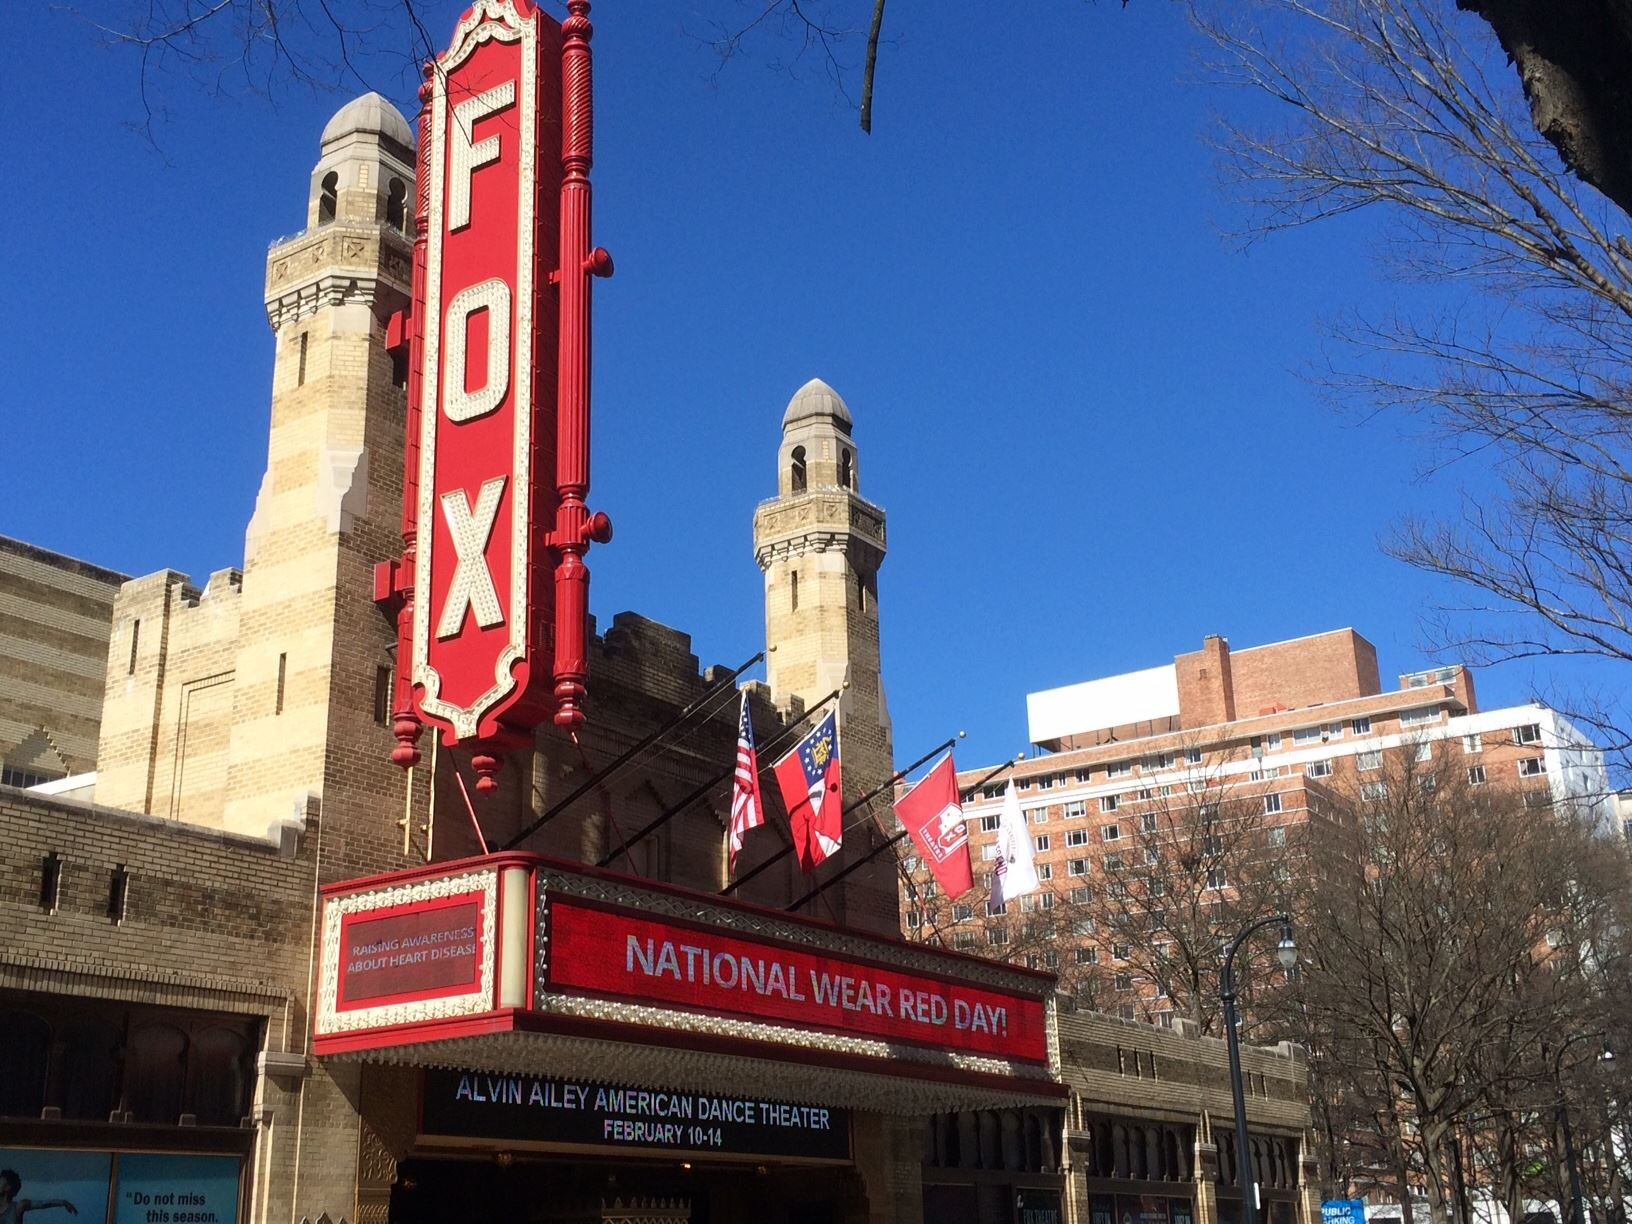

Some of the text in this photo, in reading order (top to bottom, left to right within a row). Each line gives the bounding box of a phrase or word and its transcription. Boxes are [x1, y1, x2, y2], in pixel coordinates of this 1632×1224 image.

[435, 79, 516, 640] FOX
[352, 926, 474, 957] RAISING AWARENESS
[347, 957, 388, 973] ABOUT
[389, 951, 428, 967] HEART
[626, 934, 1007, 1037] NATIONAL WEAR RED DAY!
[456, 1075, 830, 1130] ALVIN AILEY AMERICAN DANCE THEATER
[604, 1119, 722, 1147] FEBRUARY 10-14
[153, 1192, 175, 1206] not
[177, 1191, 206, 1206] miss
[146, 1209, 219, 1224] this season.
